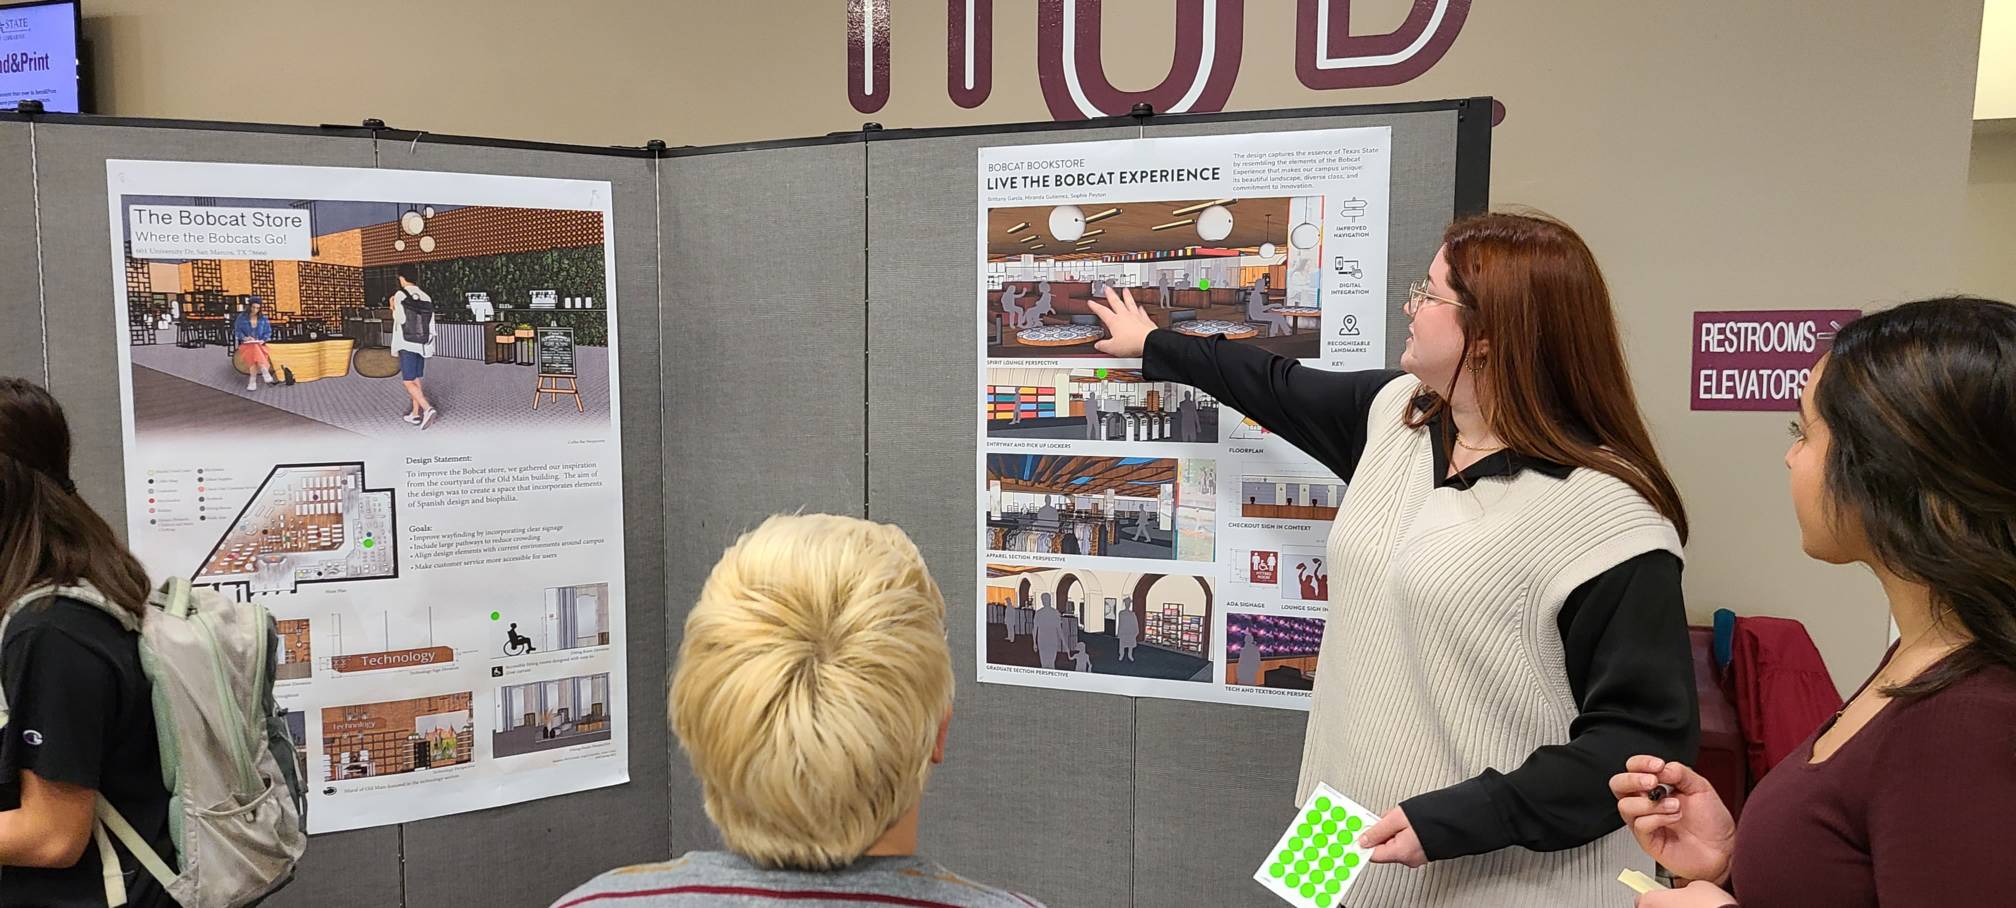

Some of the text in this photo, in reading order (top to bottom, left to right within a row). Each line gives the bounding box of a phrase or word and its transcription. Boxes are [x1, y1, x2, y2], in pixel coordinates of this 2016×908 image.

[5, 17, 28, 29] STATE
[988, 158, 1085, 172] BOBCAT BOOKSTORE
[987, 167, 1221, 190] LIVE THE BOBCAT EXPERIENCE
[134, 208, 302, 228] The Bobcat Store
[135, 231, 287, 245] Where the Bobcats Go!
[1701, 320, 1816, 353] RESTROOMS
[1699, 368, 1811, 399] ELEVATORS
[406, 455, 472, 465] Design Statement:
[407, 470, 416, 478] To
[418, 470, 448, 478] improve
[463, 467, 486, 475] Bobcat
[519, 464, 547, 473] gathered
[562, 463, 596, 471] inspiration
[440, 478, 474, 487] courtyard
[421, 490, 445, 498] design
[497, 486, 517, 494] space
[532, 483, 573, 491] incorporates
[417, 500, 445, 509] Spanish
[446, 498, 469, 506] design
[409, 524, 433, 532] Goals:
[441, 531, 476, 540] wayfinding
[485, 528, 526, 536] incorporating
[542, 525, 564, 533] signage
[455, 539, 484, 548] pathways
[521, 542, 560, 550] environments
[433, 561, 462, 569] customer
[503, 554, 531, 562] accessible
[361, 651, 435, 666] Technology
[1036, 670, 1069, 678] PERSPECTIVE
[1255, 688, 1286, 696] TEXTBOOK
[333, 719, 376, 730] Technology
